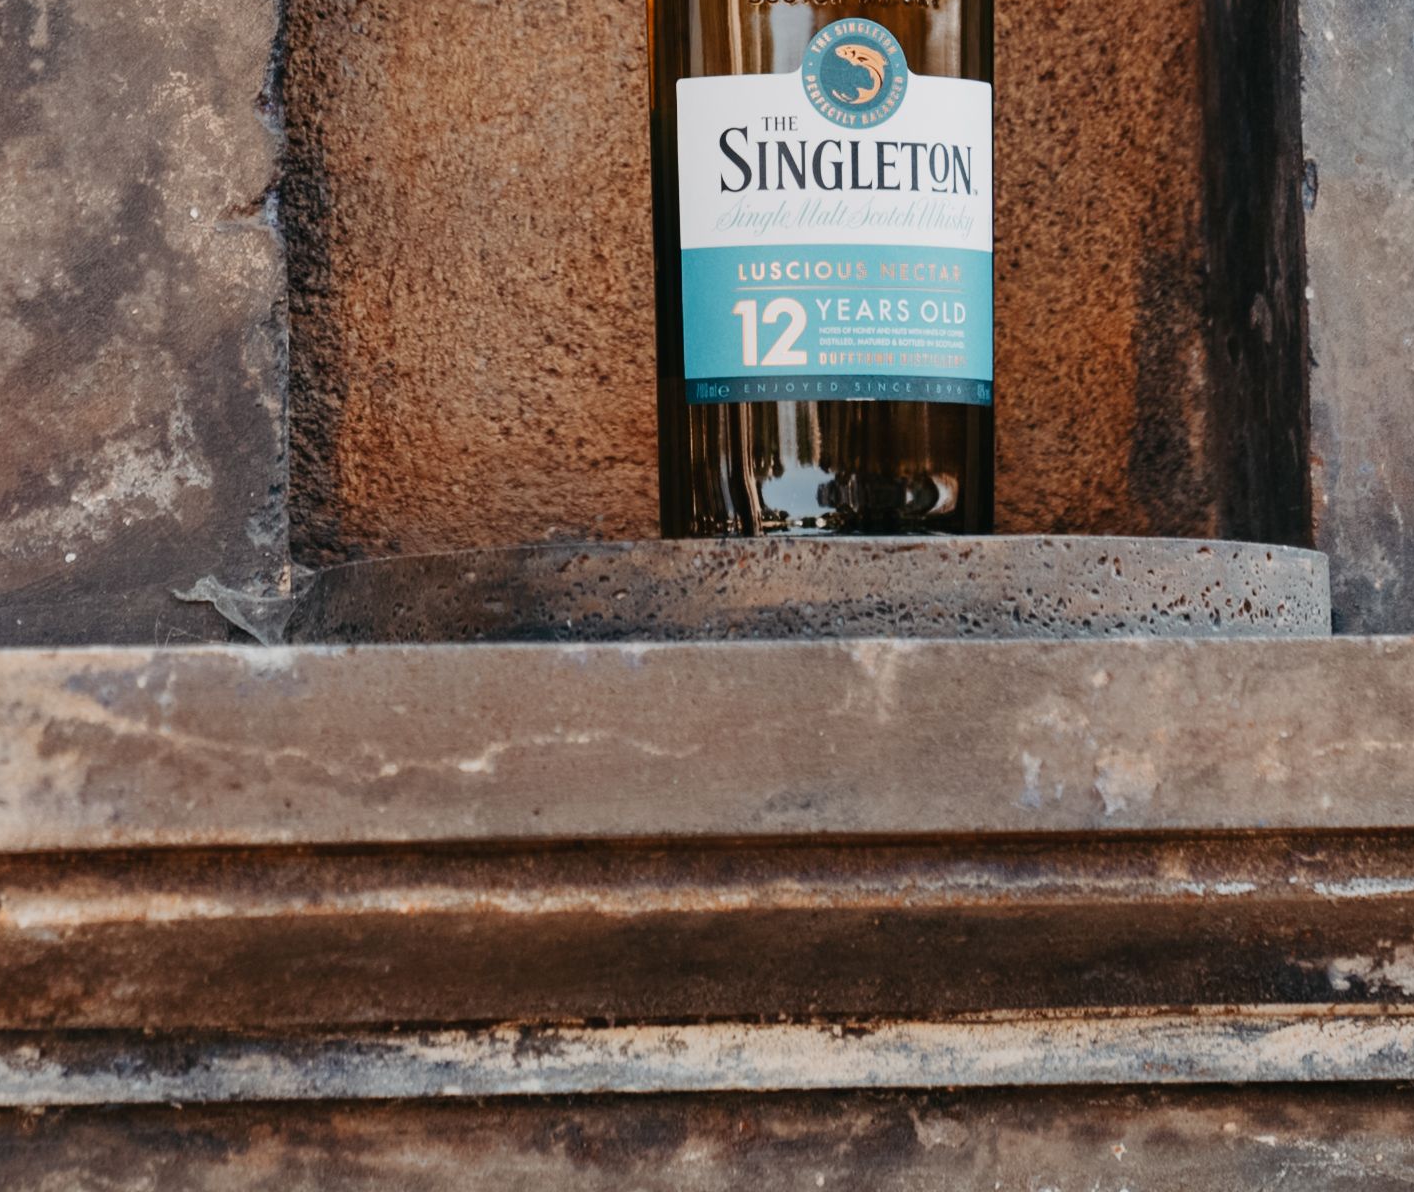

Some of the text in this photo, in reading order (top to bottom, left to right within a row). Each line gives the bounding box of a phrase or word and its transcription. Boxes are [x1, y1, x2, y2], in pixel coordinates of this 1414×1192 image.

[810, 22, 898, 56] THE SINGLETON
[804, 73, 904, 125] PERFECTLY BALANCED
[761, 115, 799, 132] THE
[719, 126, 974, 196] SINGLETON
[712, 195, 976, 240] Single Malt Scotch Whisky
[738, 260, 963, 283] LUSCIOUS NECTAR
[815, 298, 967, 325] YEARS OLD
[731, 297, 808, 367] 12
[819, 351, 895, 366] DUFFTOWN
[743, 382, 839, 394] ENJOYED
[854, 382, 911, 394] SINCE
[925, 383, 963, 395] 1896
